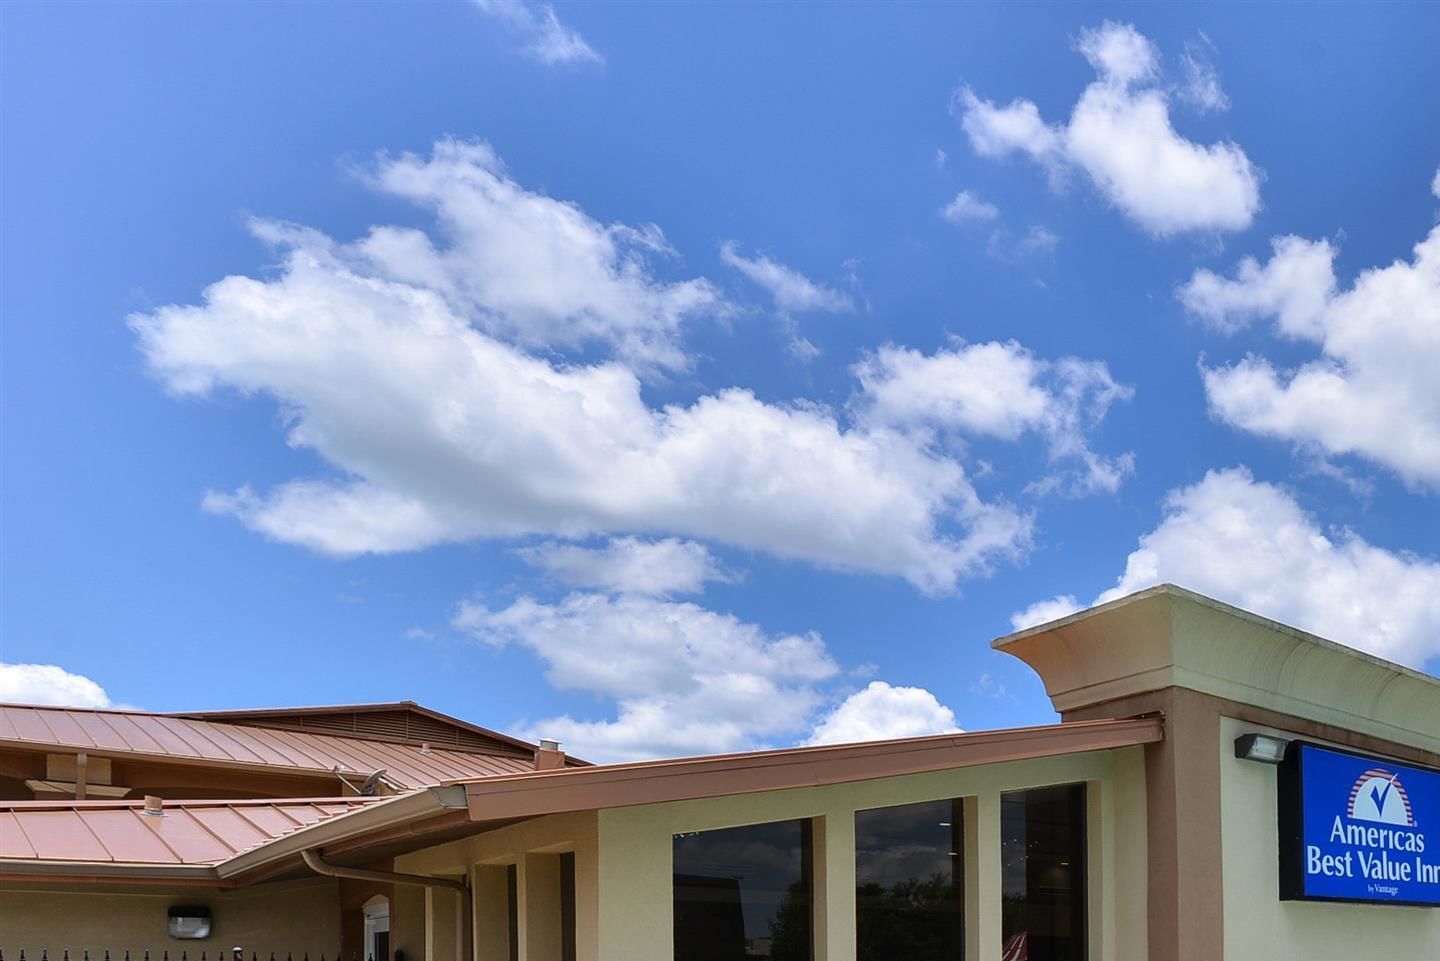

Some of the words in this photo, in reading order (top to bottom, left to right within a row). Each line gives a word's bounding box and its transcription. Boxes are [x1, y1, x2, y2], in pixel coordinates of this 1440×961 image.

[1330, 815, 1425, 853] Americas
[1307, 845, 1353, 878] Best
[1357, 850, 1411, 882] Value
